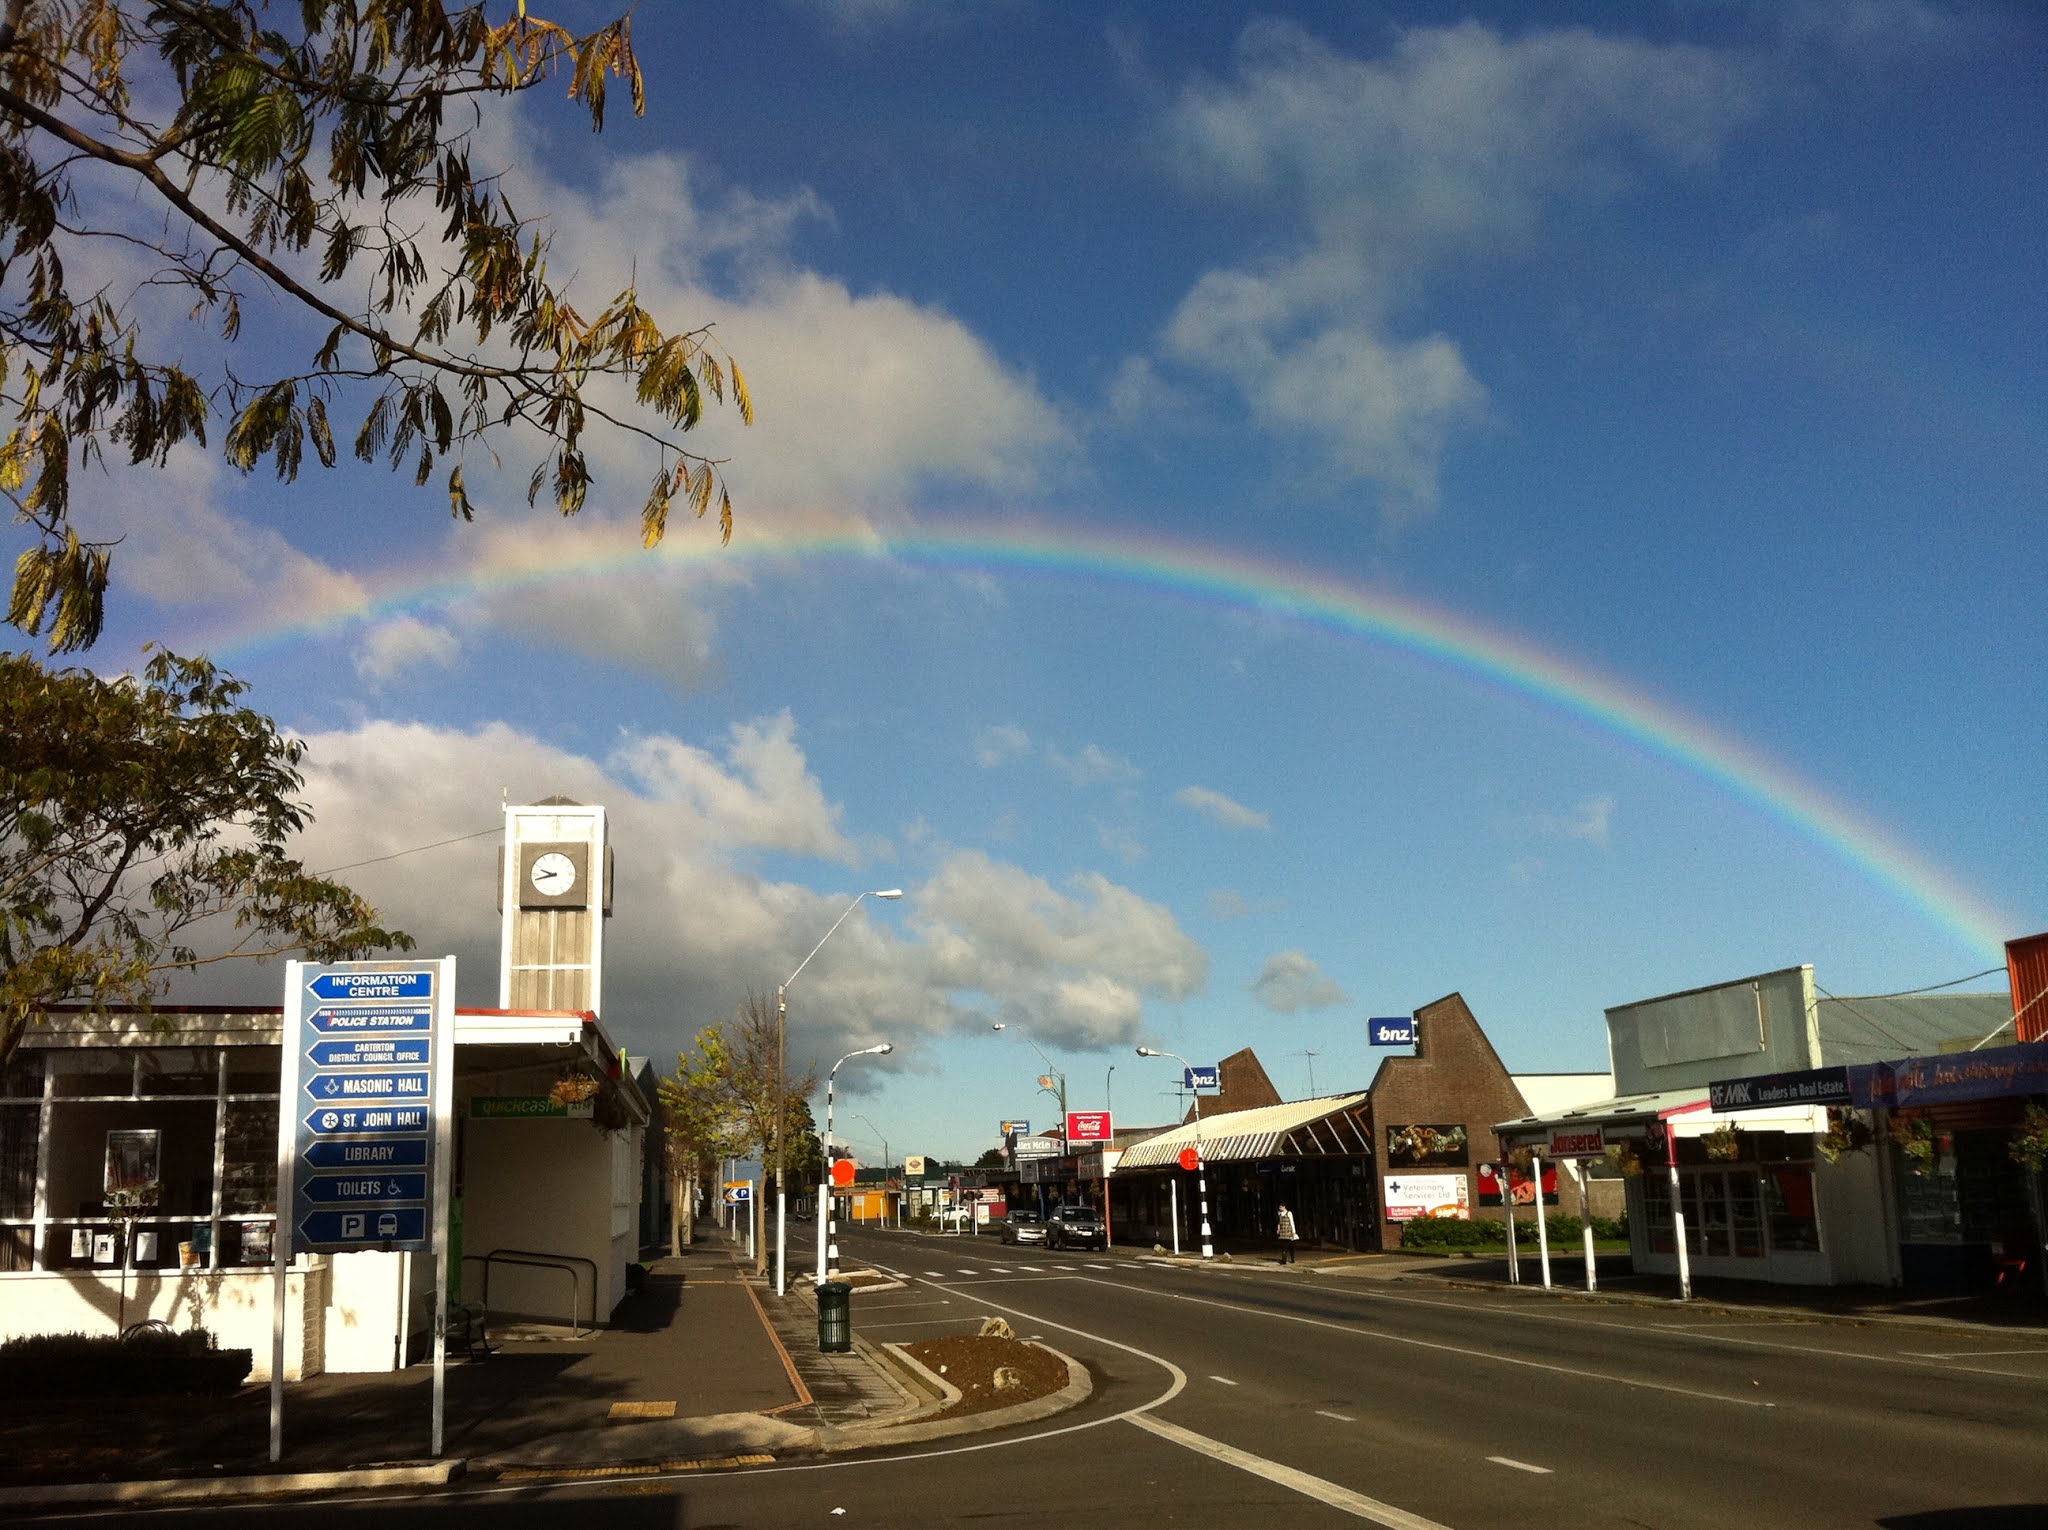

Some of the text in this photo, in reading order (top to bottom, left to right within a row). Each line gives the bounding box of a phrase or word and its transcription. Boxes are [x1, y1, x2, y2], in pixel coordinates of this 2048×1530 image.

[332, 975, 417, 986] INFORMATION
[349, 986, 400, 996] CENTRE
[330, 1016, 415, 1027] POLICE STATION
[1377, 1026, 1411, 1042] bnz
[355, 1043, 395, 1052] CARTERTON
[328, 1051, 420, 1063] DISTRICT COUNCIL OFFICE
[343, 1078, 422, 1093] MASONIC HALL
[1758, 1081, 1845, 1100] Leaders in Real Estate
[343, 1111, 422, 1127] ST. JOHN HALL
[345, 1146, 395, 1160] LIBRARY
[336, 1181, 381, 1196] TOILETS
[1403, 1184, 1445, 1192] Veterinary
[1438, 1191, 1451, 1199] Ltd
